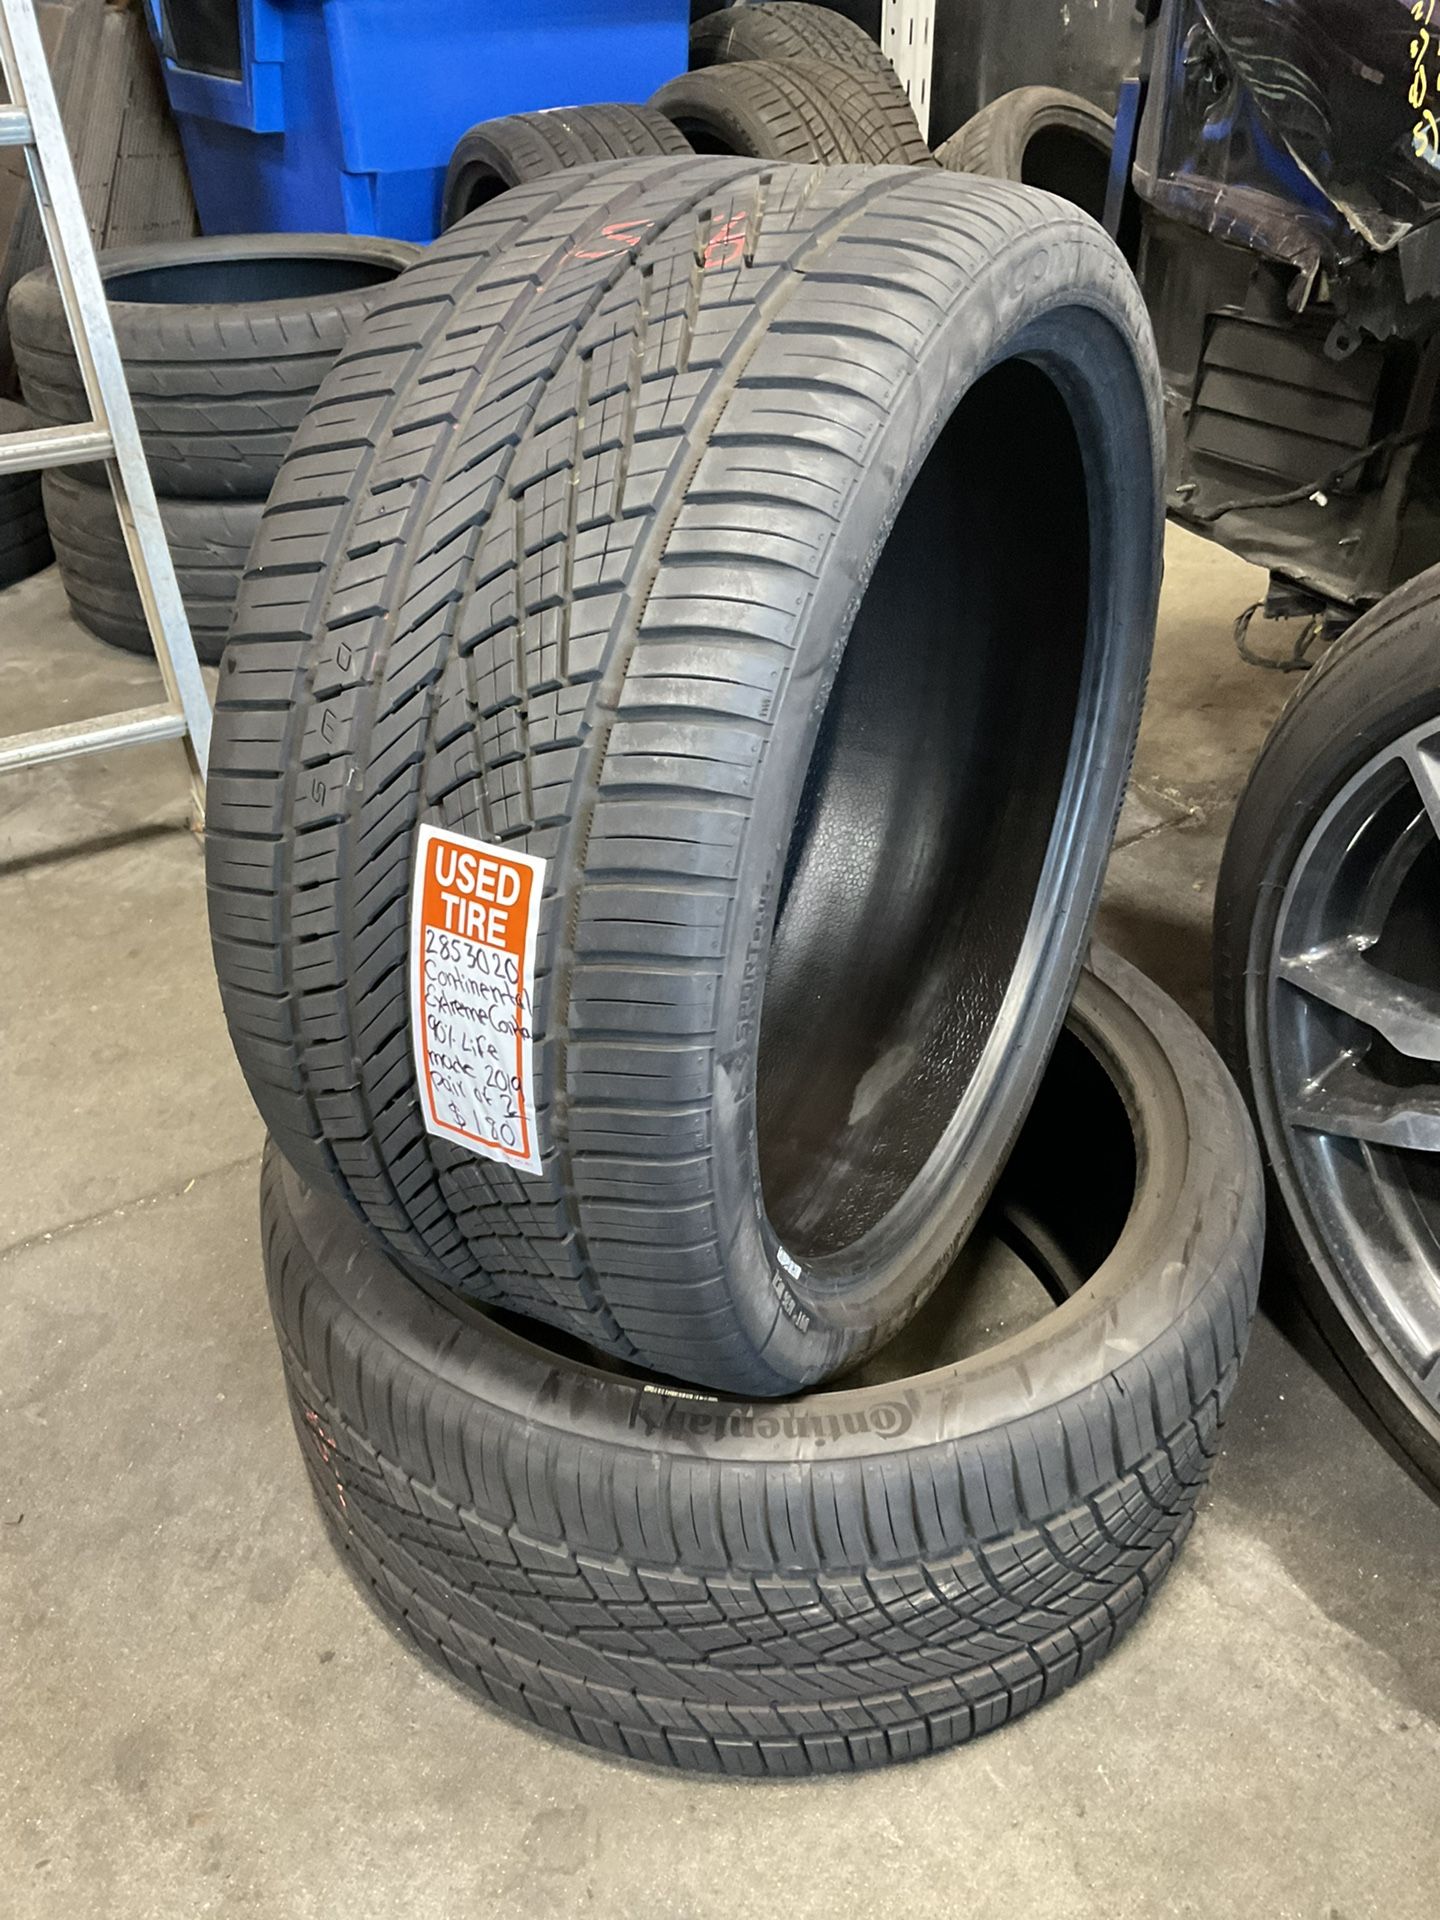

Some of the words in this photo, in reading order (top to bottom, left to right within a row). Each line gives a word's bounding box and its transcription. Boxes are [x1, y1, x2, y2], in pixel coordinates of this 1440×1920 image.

[435, 845, 521, 906] USED
[441, 893, 509, 948] TIRE
[424, 959, 533, 1018] Continental
